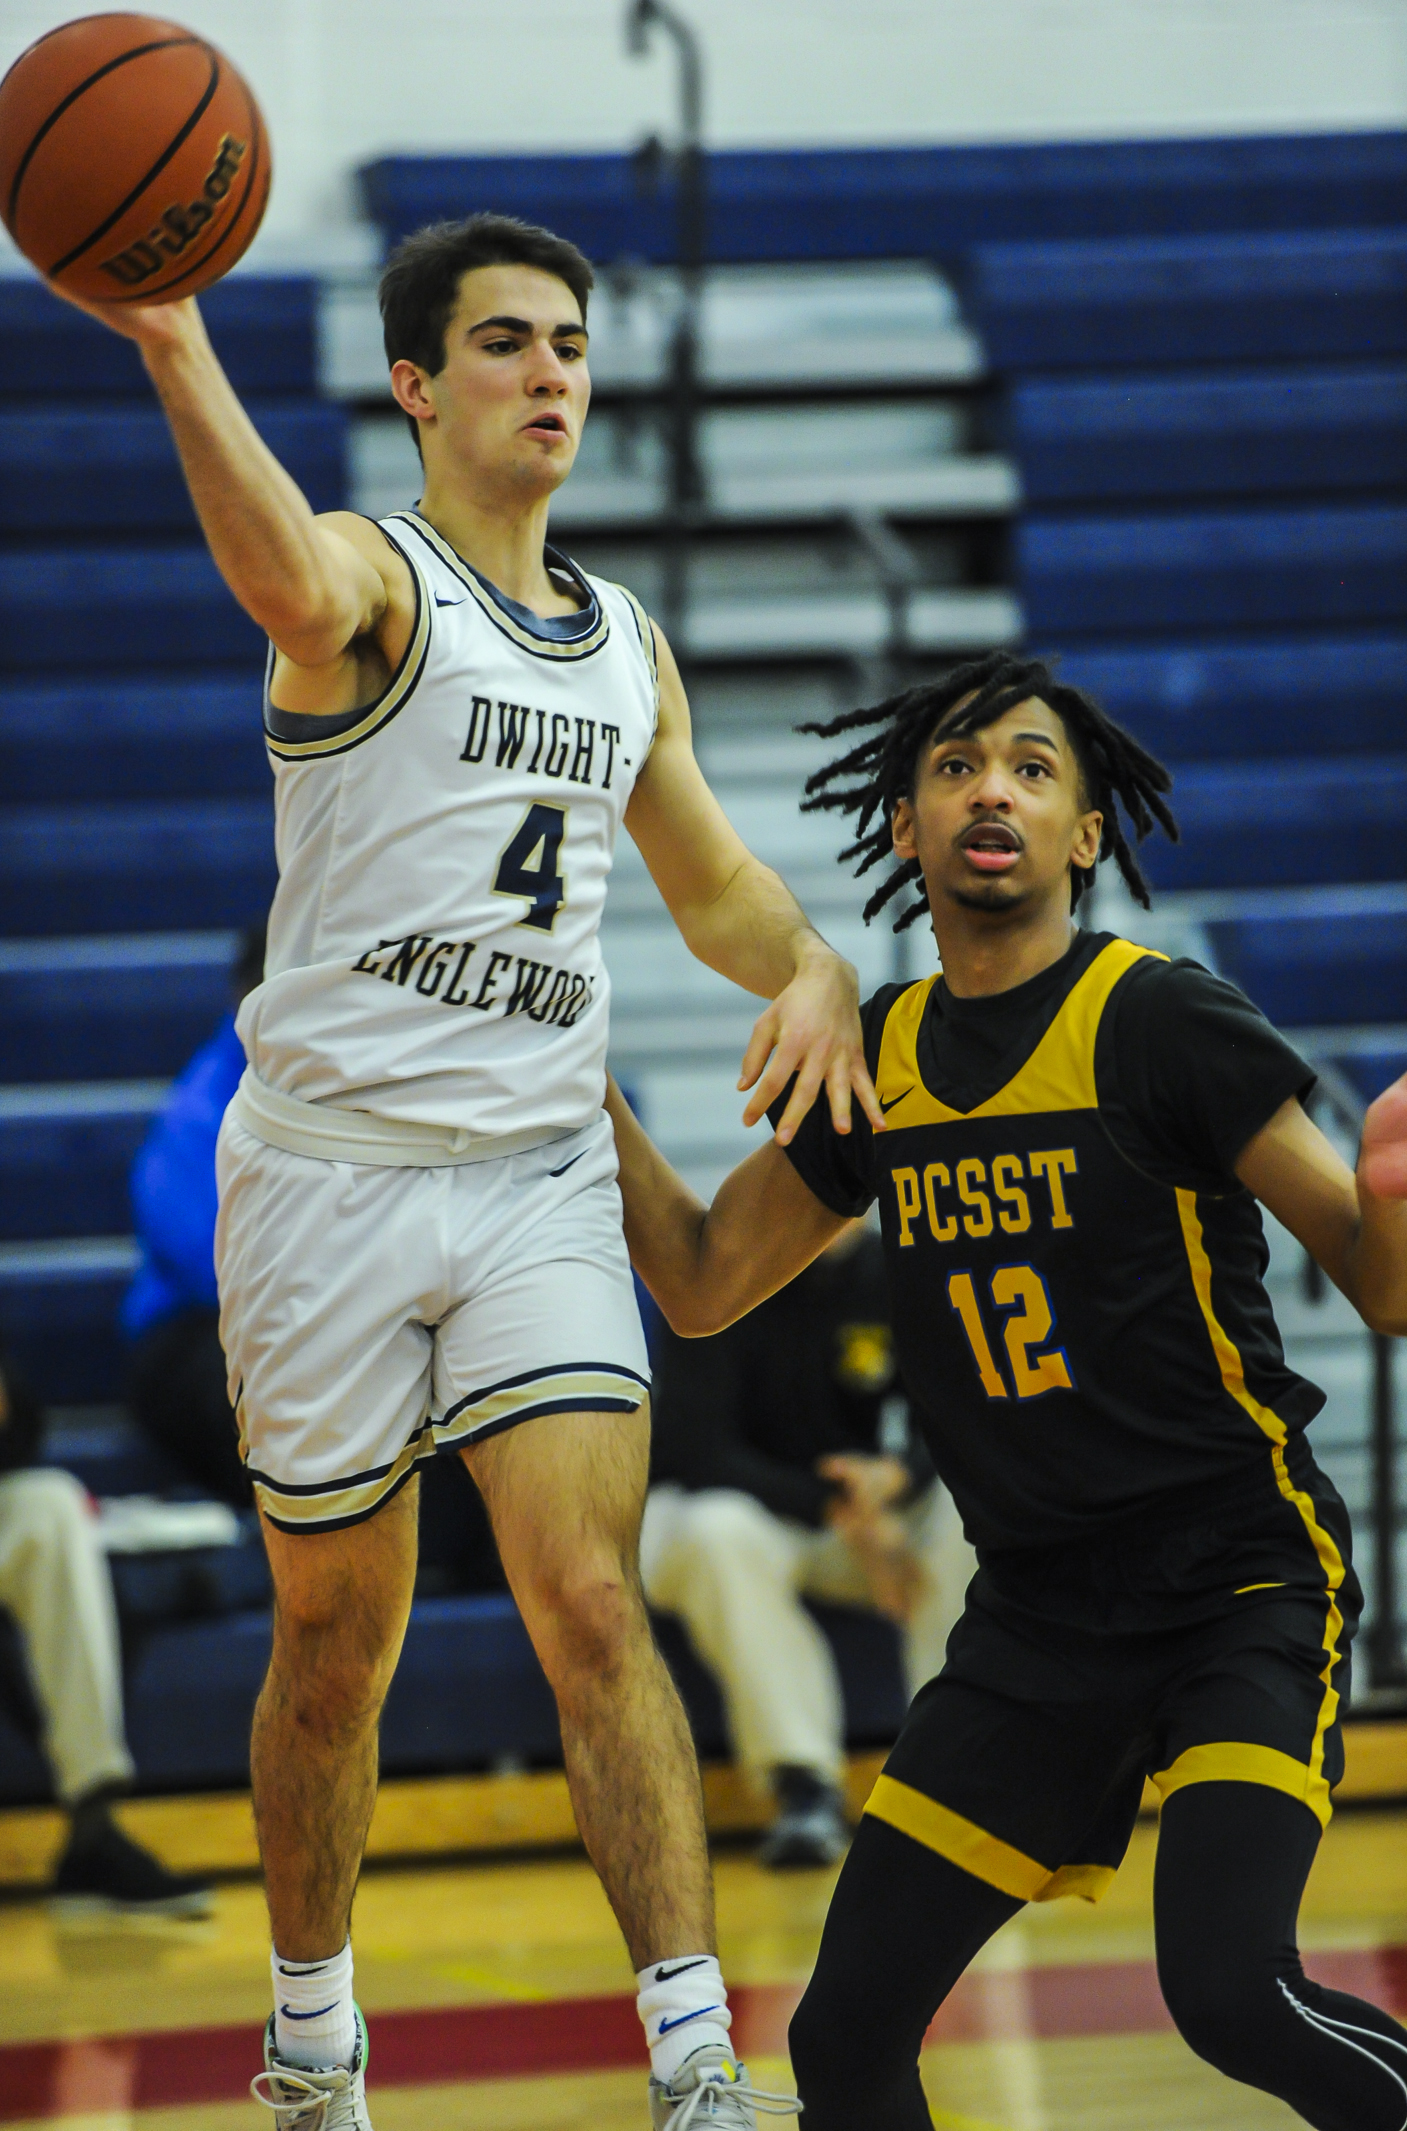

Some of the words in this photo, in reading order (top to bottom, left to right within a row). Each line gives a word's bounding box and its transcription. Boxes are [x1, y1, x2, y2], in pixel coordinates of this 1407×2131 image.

[100, 132, 246, 285] Wilson
[459, 695, 632, 789] DWIGHT-
[491, 800, 570, 936] 4
[351, 933, 595, 1028] ENGLEWOO
[891, 1147, 1078, 1247] PCSST
[946, 1261, 1077, 1401] 12
